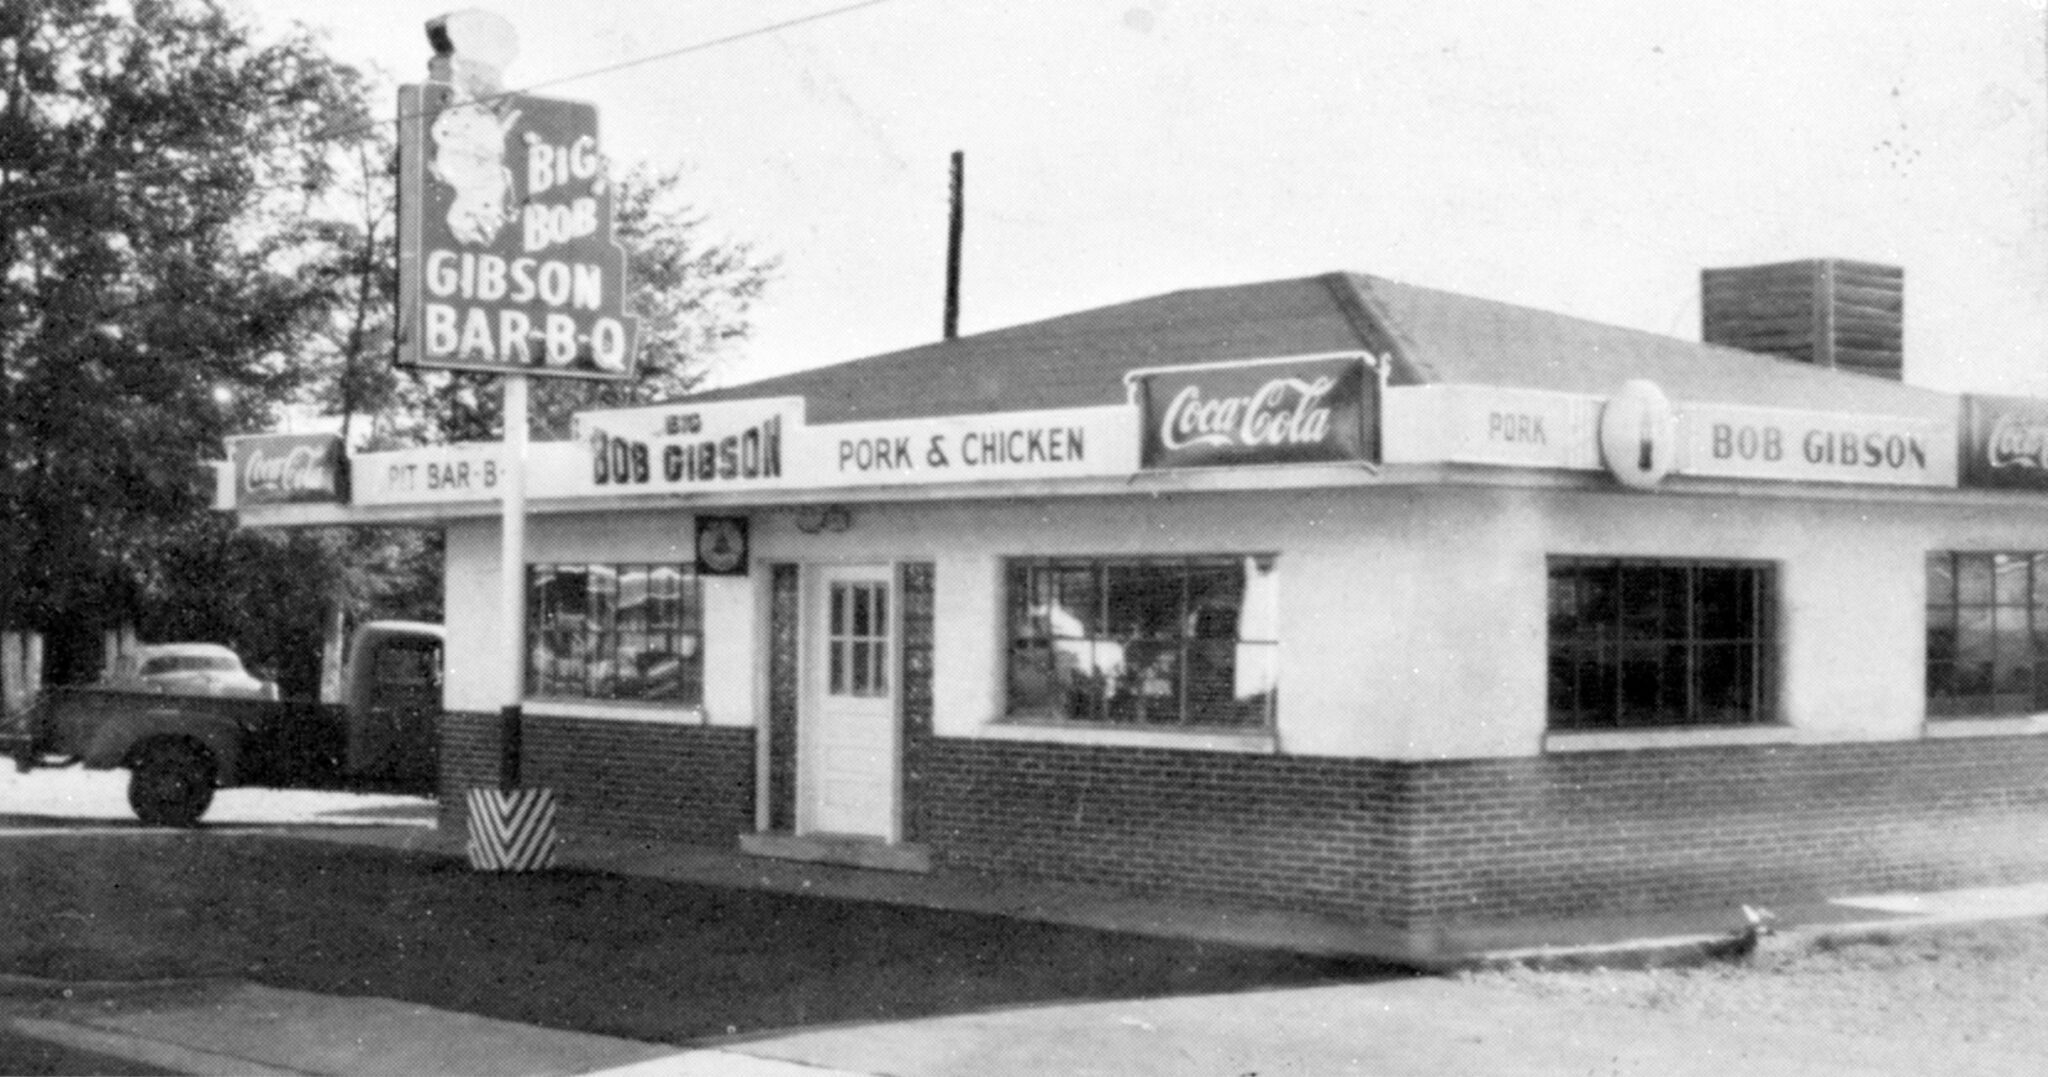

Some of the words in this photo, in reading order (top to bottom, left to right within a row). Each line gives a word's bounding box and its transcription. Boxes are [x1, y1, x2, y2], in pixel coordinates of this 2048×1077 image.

[523, 197, 598, 252] BOB
[425, 250, 601, 311] GIBSON
[425, 303, 626, 371] BAR-B-Q
[589, 427, 649, 485] BOB
[662, 413, 782, 483] GIBSON
[838, 435, 913, 472] PORK
[926, 434, 950, 467] &
[961, 426, 1085, 467] CHICKEN
[1489, 411, 1548, 446] PORK
[1711, 422, 1783, 463] BOB
[1802, 429, 1926, 470] GIBSON
[388, 463, 418, 491] PIT
